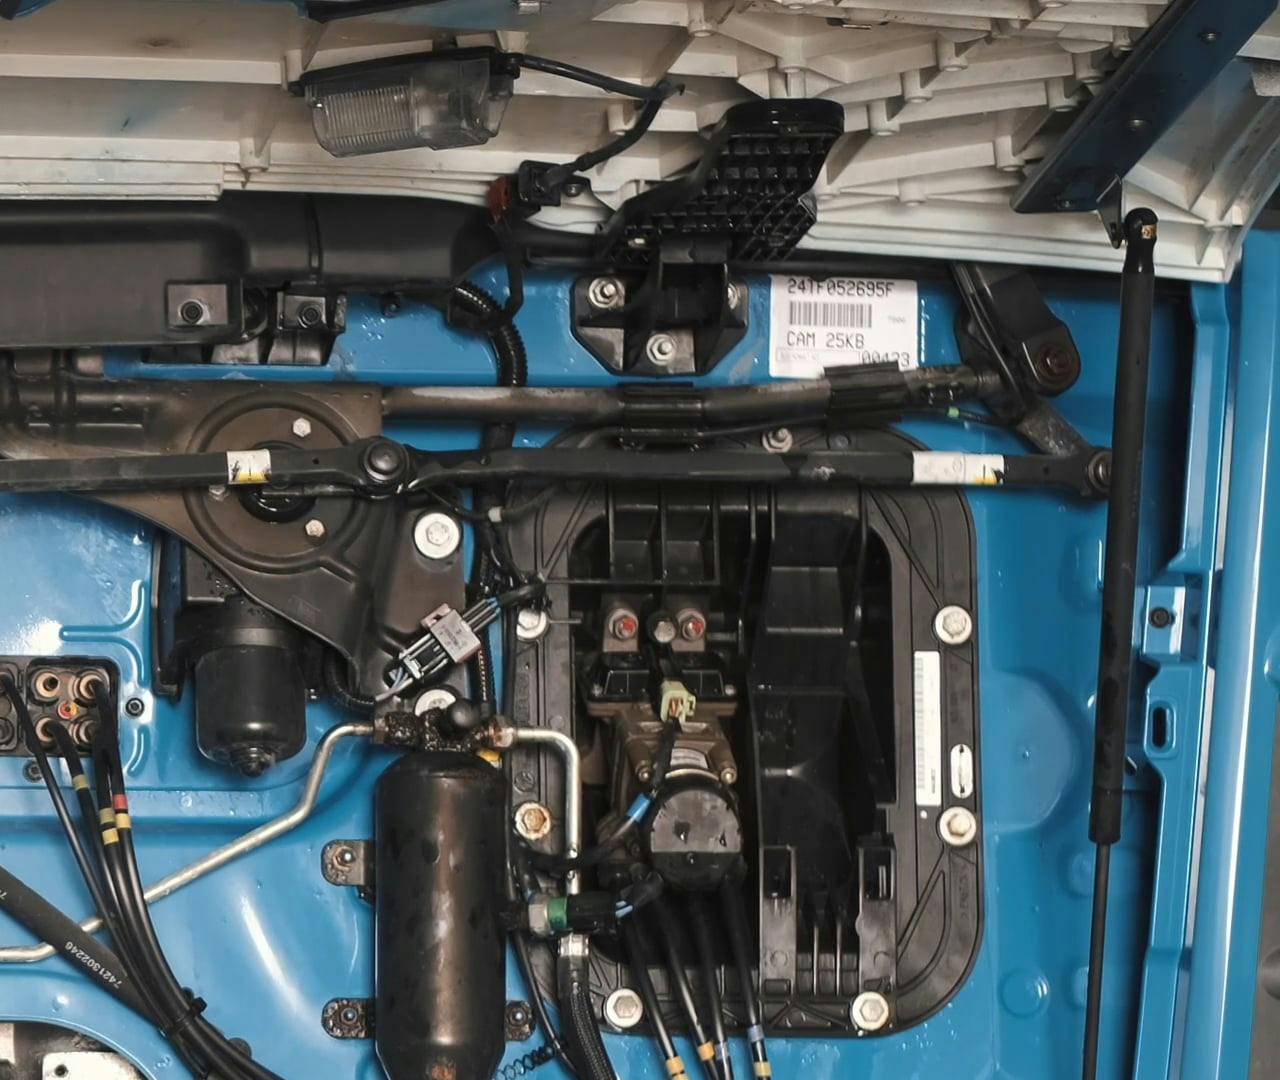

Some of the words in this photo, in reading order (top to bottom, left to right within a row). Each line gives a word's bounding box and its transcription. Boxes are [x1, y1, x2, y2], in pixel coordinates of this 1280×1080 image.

[786, 331, 816, 347] CAM
[826, 332, 865, 349] 25KB
[64, 941, 123, 989] 7421302246
